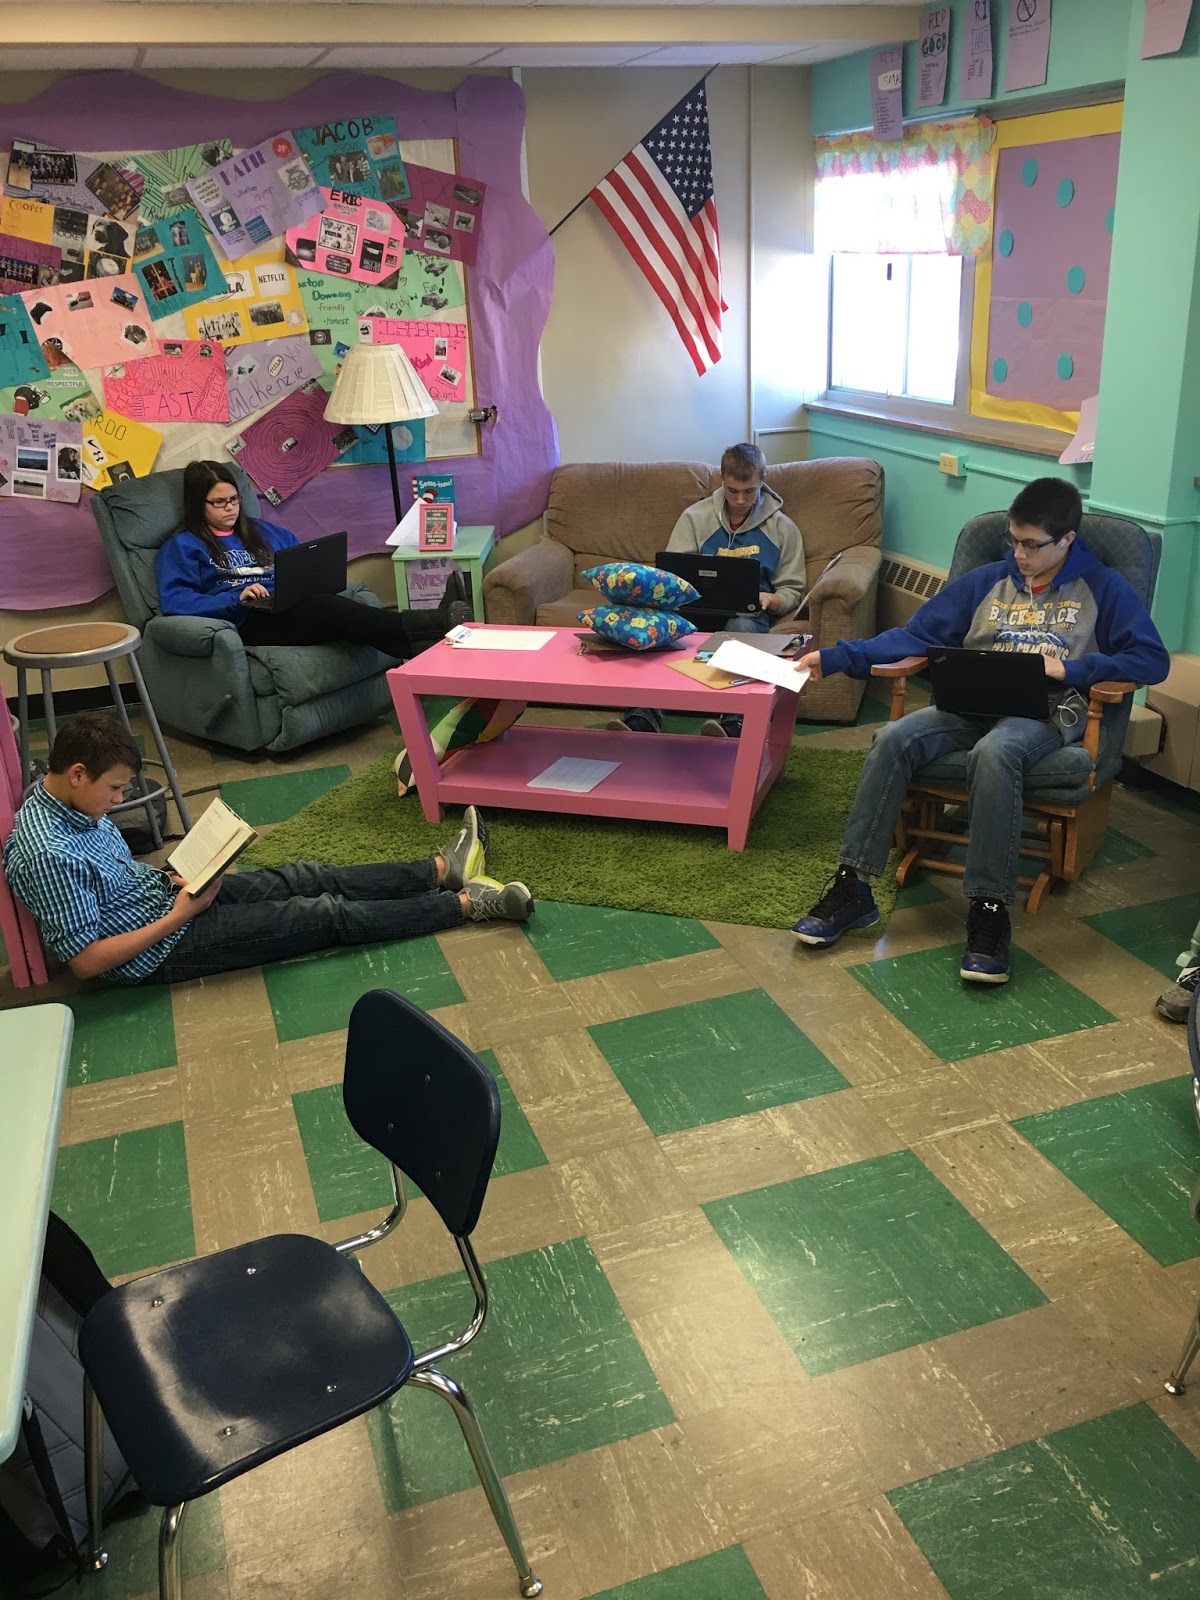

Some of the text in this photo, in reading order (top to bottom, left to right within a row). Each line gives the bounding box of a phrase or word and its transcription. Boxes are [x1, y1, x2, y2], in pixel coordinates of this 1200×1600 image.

[928, 9, 947, 31] RIP
[922, 32, 947, 55] GOOD
[311, 117, 374, 146] JACOB
[330, 189, 363, 207] ERIC
[258, 273, 286, 285] NETFLIX
[141, 390, 194, 418] FAST
[419, 479, 453, 489] Seuss-isms!
